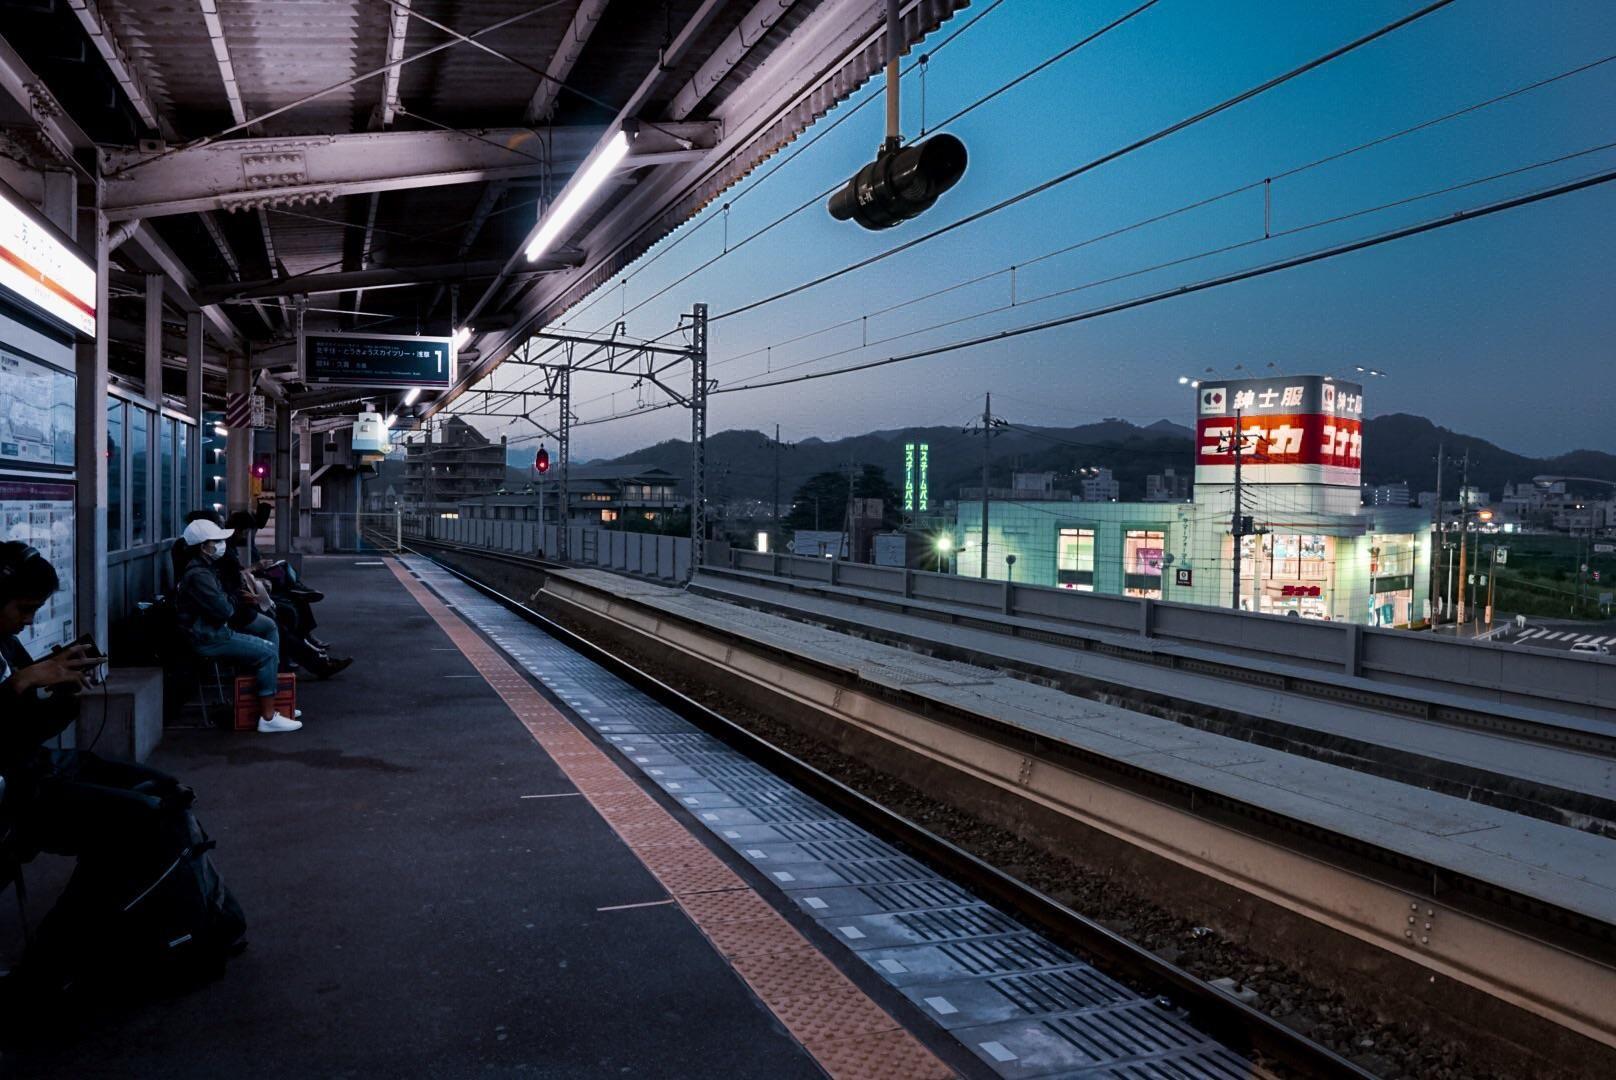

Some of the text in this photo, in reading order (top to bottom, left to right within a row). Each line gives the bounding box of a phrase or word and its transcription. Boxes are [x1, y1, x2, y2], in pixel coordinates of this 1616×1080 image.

[434, 350, 442, 373] 1
[1233, 386, 1305, 409] 紳士服
[1201, 424, 1304, 456] コナカ
[1320, 424, 1362, 459] コナカ
